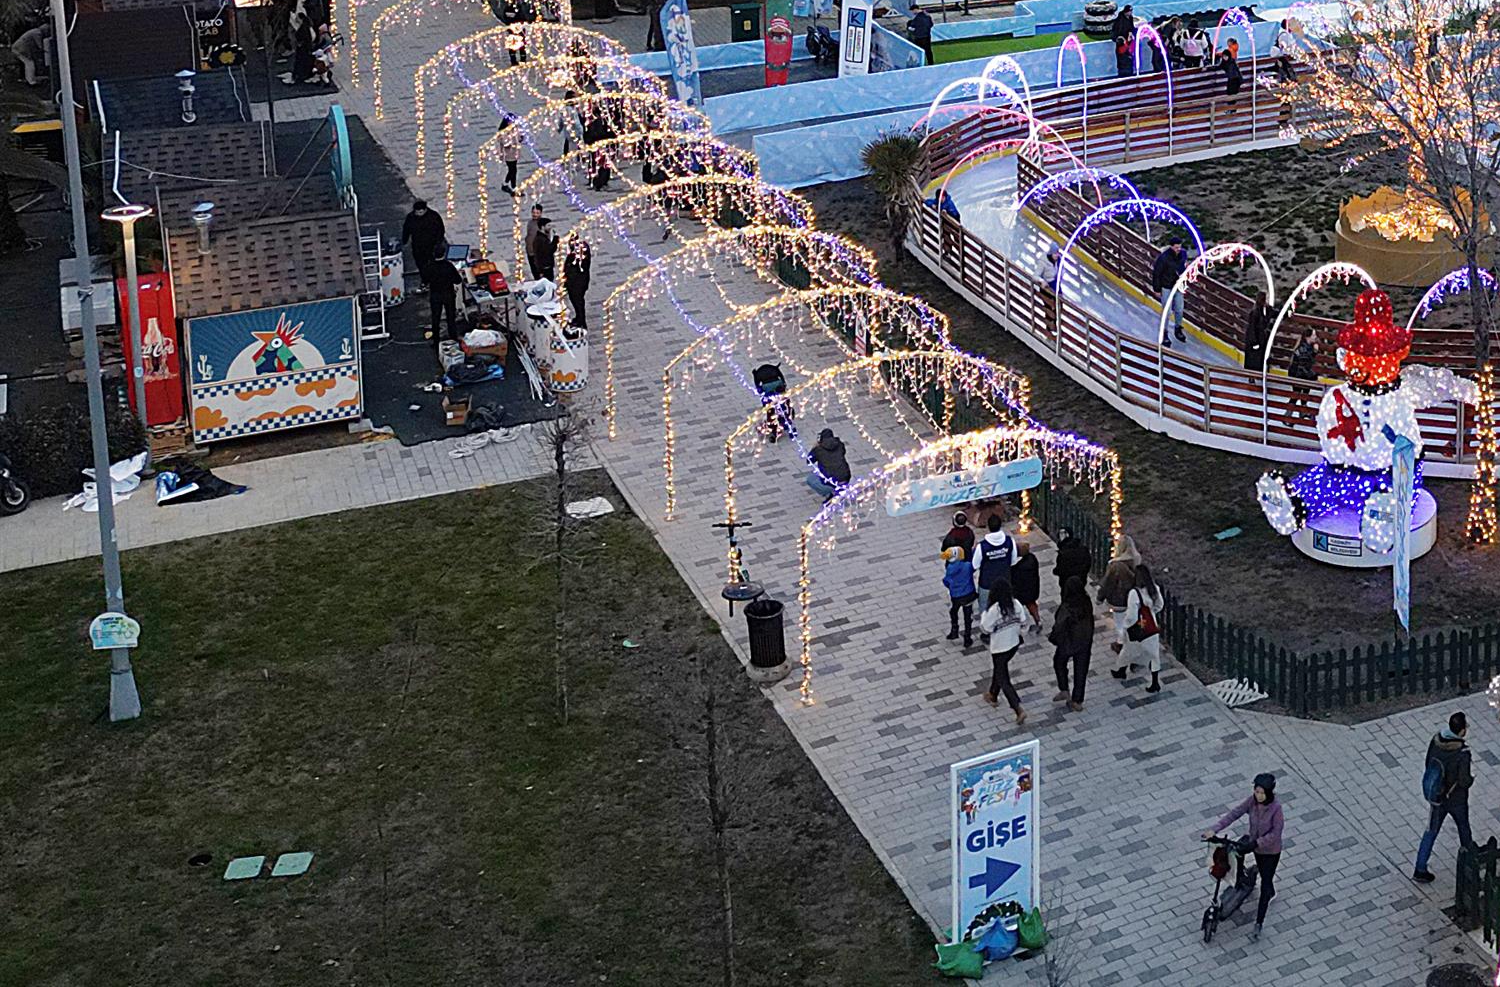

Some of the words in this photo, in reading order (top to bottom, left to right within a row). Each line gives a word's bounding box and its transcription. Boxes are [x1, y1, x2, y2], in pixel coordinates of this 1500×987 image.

[929, 482, 1001, 507] BUZZFEST
[978, 789, 1009, 808] FEST
[965, 815, 1027, 853] GİŞE
